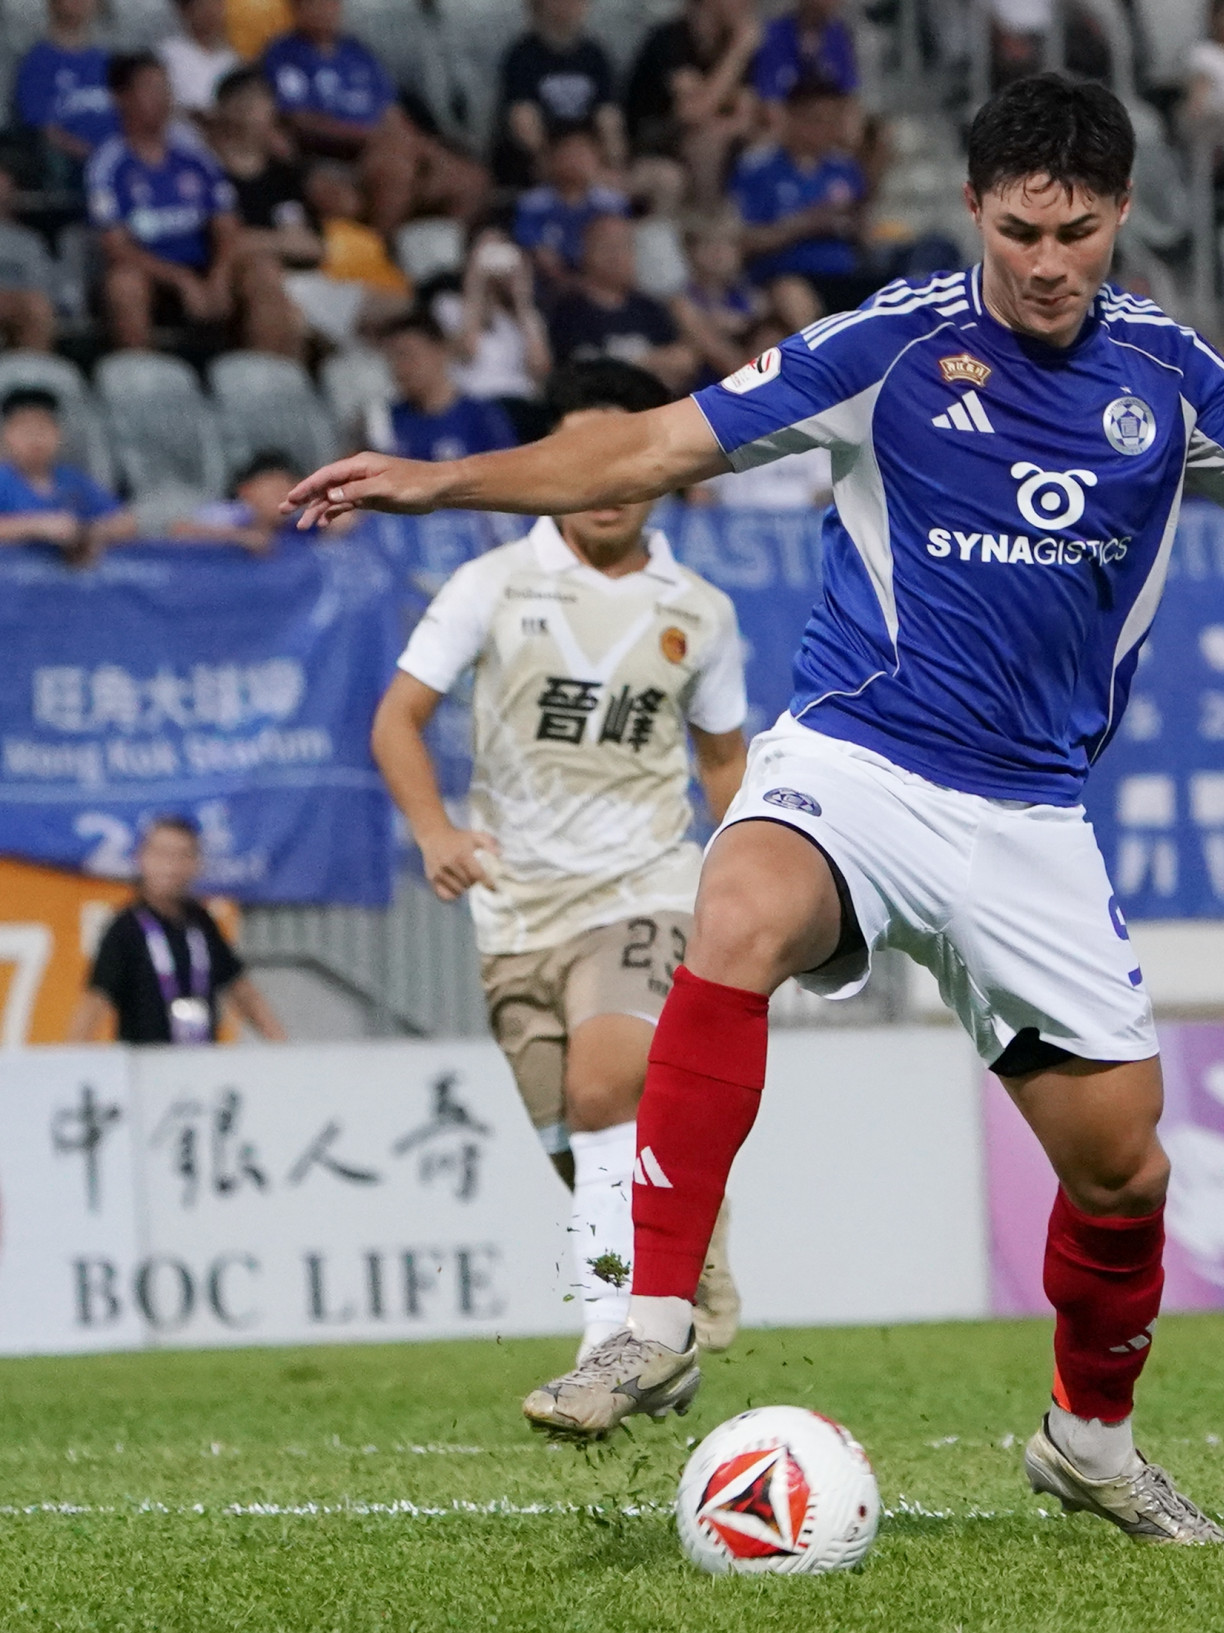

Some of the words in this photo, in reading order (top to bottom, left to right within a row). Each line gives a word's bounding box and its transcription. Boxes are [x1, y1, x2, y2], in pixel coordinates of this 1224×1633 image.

[926, 527, 1132, 567] SYNAGISTICS
[536, 676, 668, 753] 晉峰
[72, 1250, 262, 1330] BOC
[304, 1243, 507, 1325] LIFE
